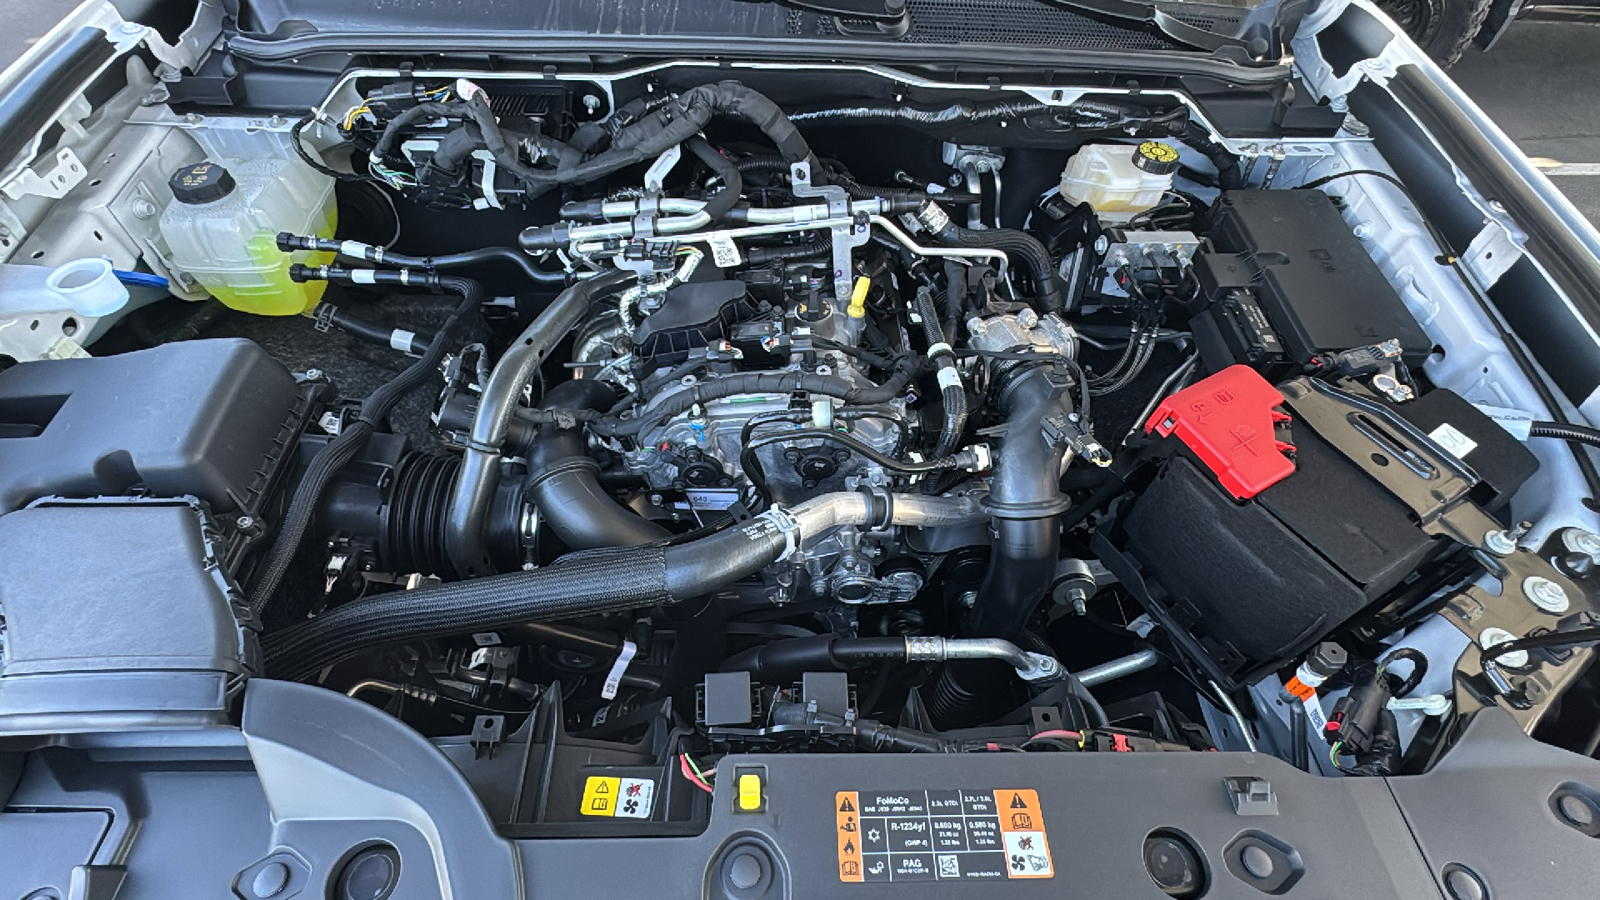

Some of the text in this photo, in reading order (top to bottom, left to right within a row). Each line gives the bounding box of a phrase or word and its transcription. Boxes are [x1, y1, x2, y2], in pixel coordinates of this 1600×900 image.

[876, 797, 909, 805] FoMoCo
[953, 822, 961, 830] kg
[987, 821, 996, 830] kg
[903, 859, 922, 867] PAG
